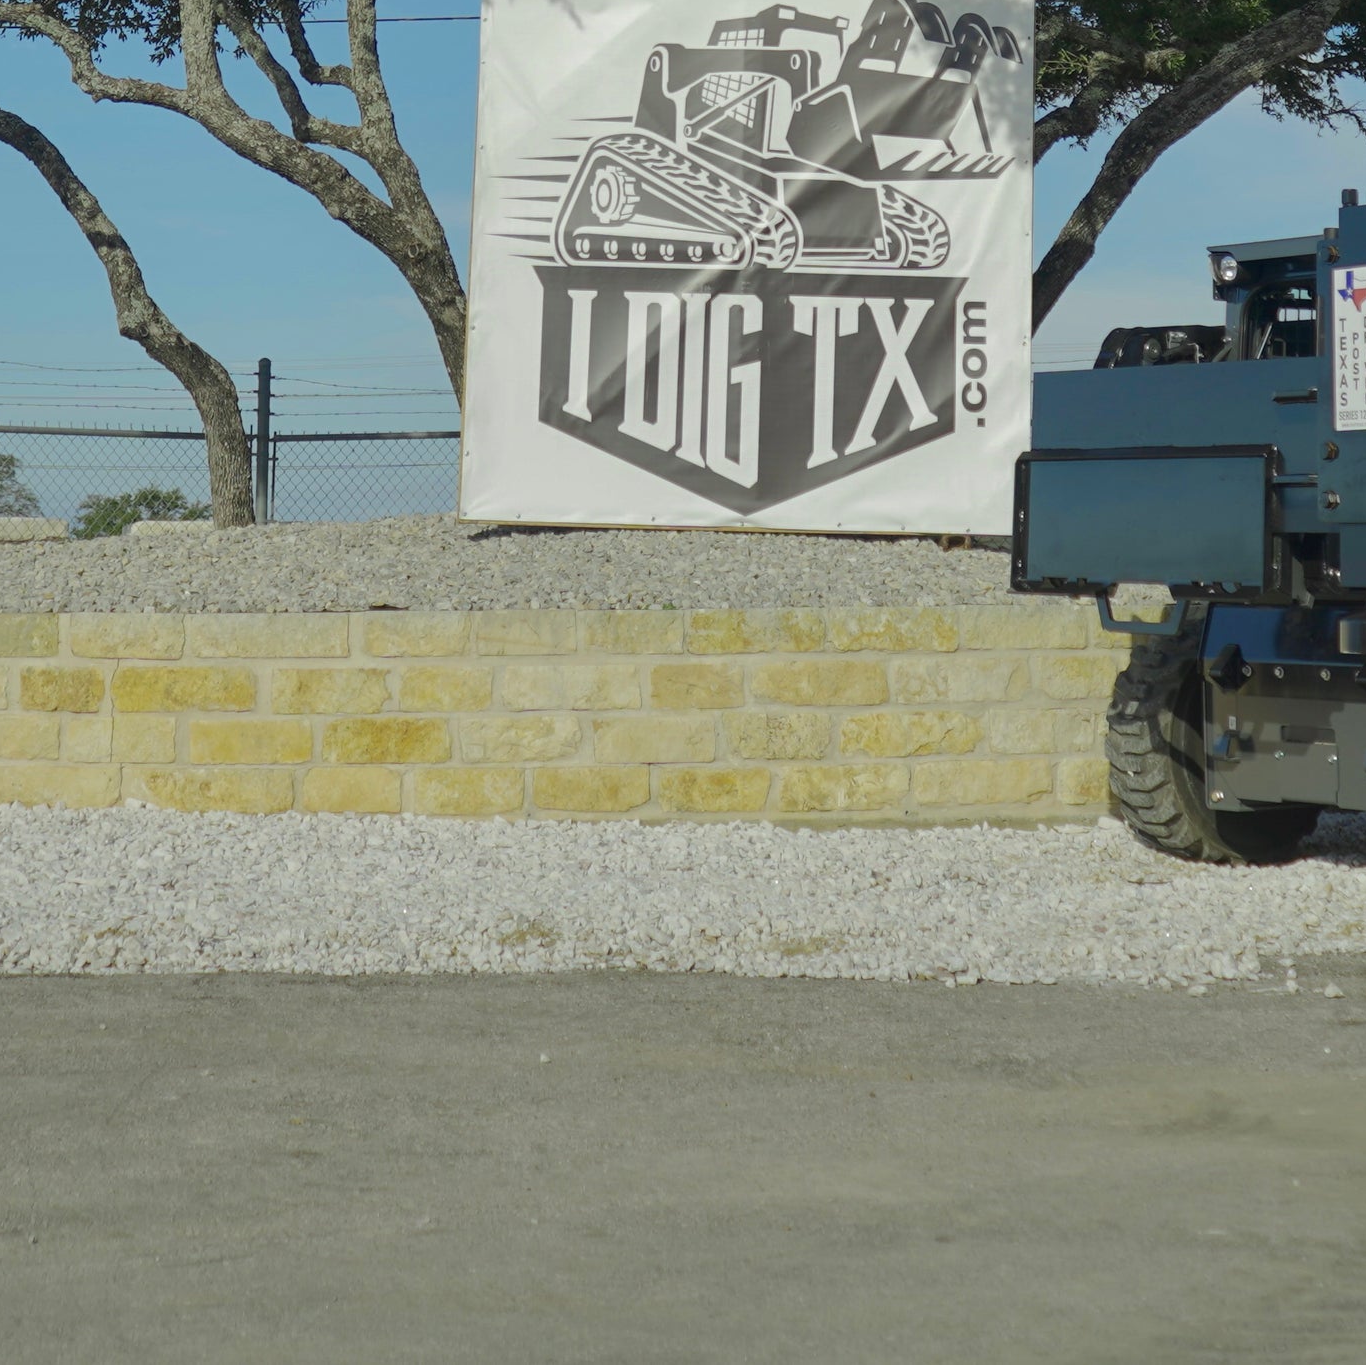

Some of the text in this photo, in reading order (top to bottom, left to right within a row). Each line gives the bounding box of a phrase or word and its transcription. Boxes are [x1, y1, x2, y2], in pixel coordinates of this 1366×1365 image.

[561, 289, 939, 490] I DIG TX
[962, 300, 988, 428] .com
[1339, 318, 1348, 407] TEXAS
[1352, 332, 1360, 391] POST
[1338, 410, 1359, 421] SERIES
